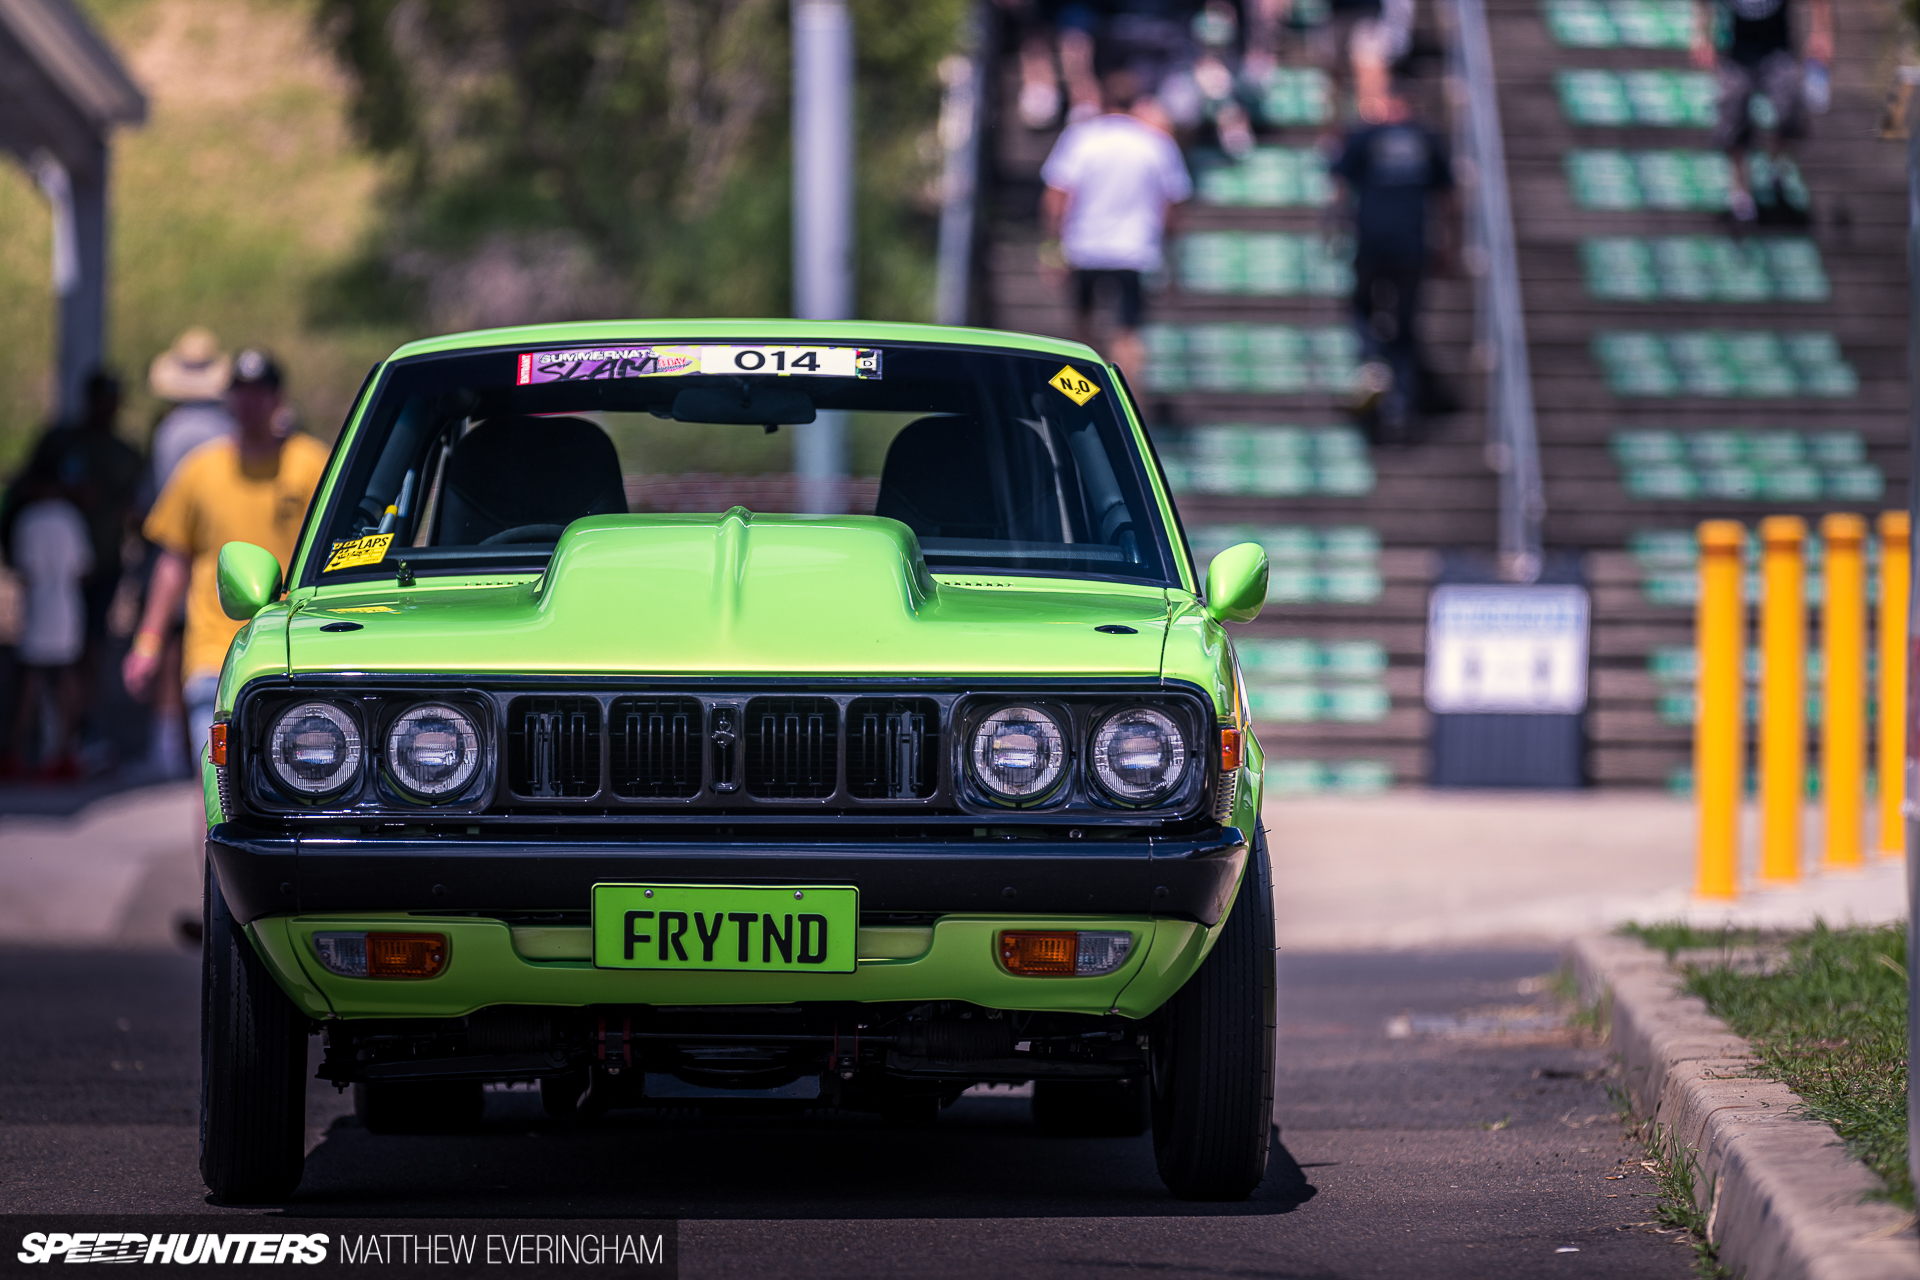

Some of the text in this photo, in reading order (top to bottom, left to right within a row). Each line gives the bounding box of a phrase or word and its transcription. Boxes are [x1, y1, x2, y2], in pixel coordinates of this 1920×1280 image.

[540, 348, 660, 363] SUMMERNATS
[667, 357, 686, 366] DAY
[734, 350, 821, 371] 014
[520, 354, 532, 384] ENTRANT
[358, 537, 389, 550] LAPS
[623, 910, 827, 963] FRYTND
